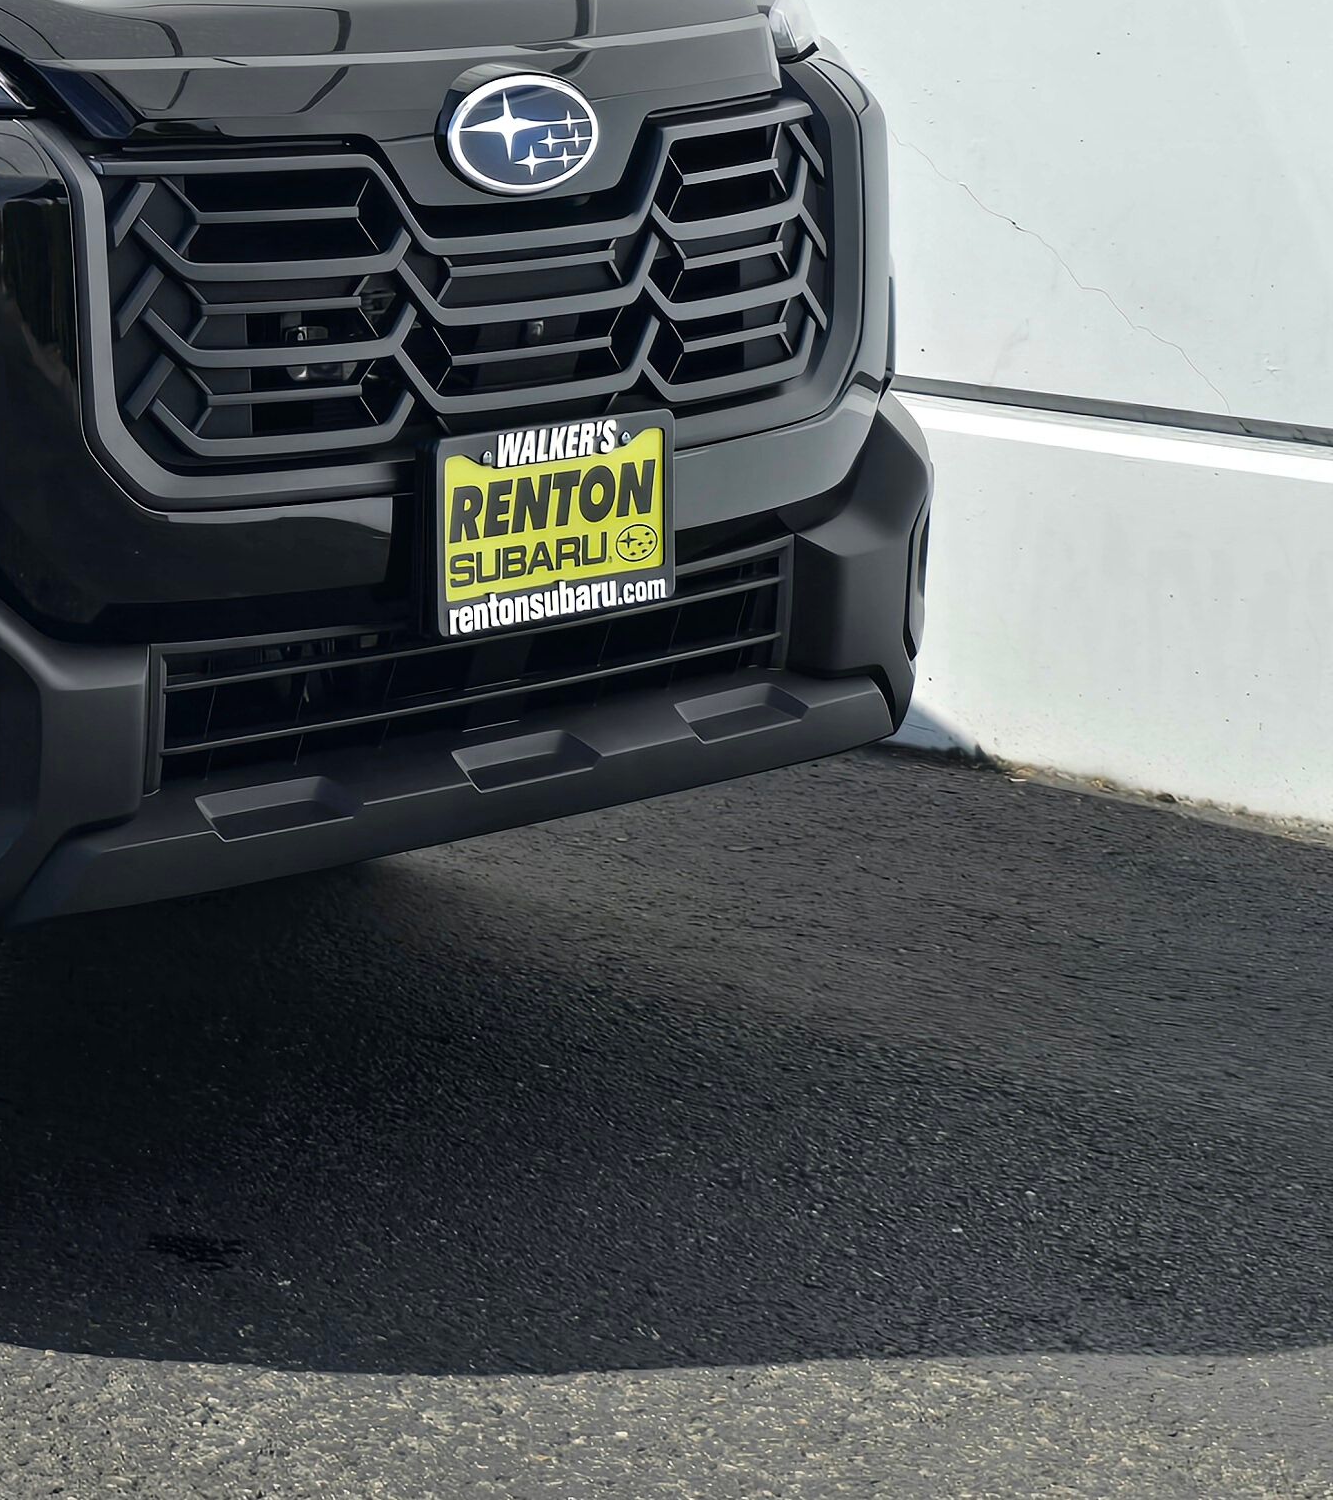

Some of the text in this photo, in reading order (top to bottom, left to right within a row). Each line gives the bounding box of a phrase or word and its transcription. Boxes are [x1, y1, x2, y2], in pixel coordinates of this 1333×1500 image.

[496, 419, 618, 468] WALKER'S
[449, 459, 656, 544] RENTON
[449, 531, 608, 588] SUBARU
[448, 579, 667, 636] rentonsubaru.com
